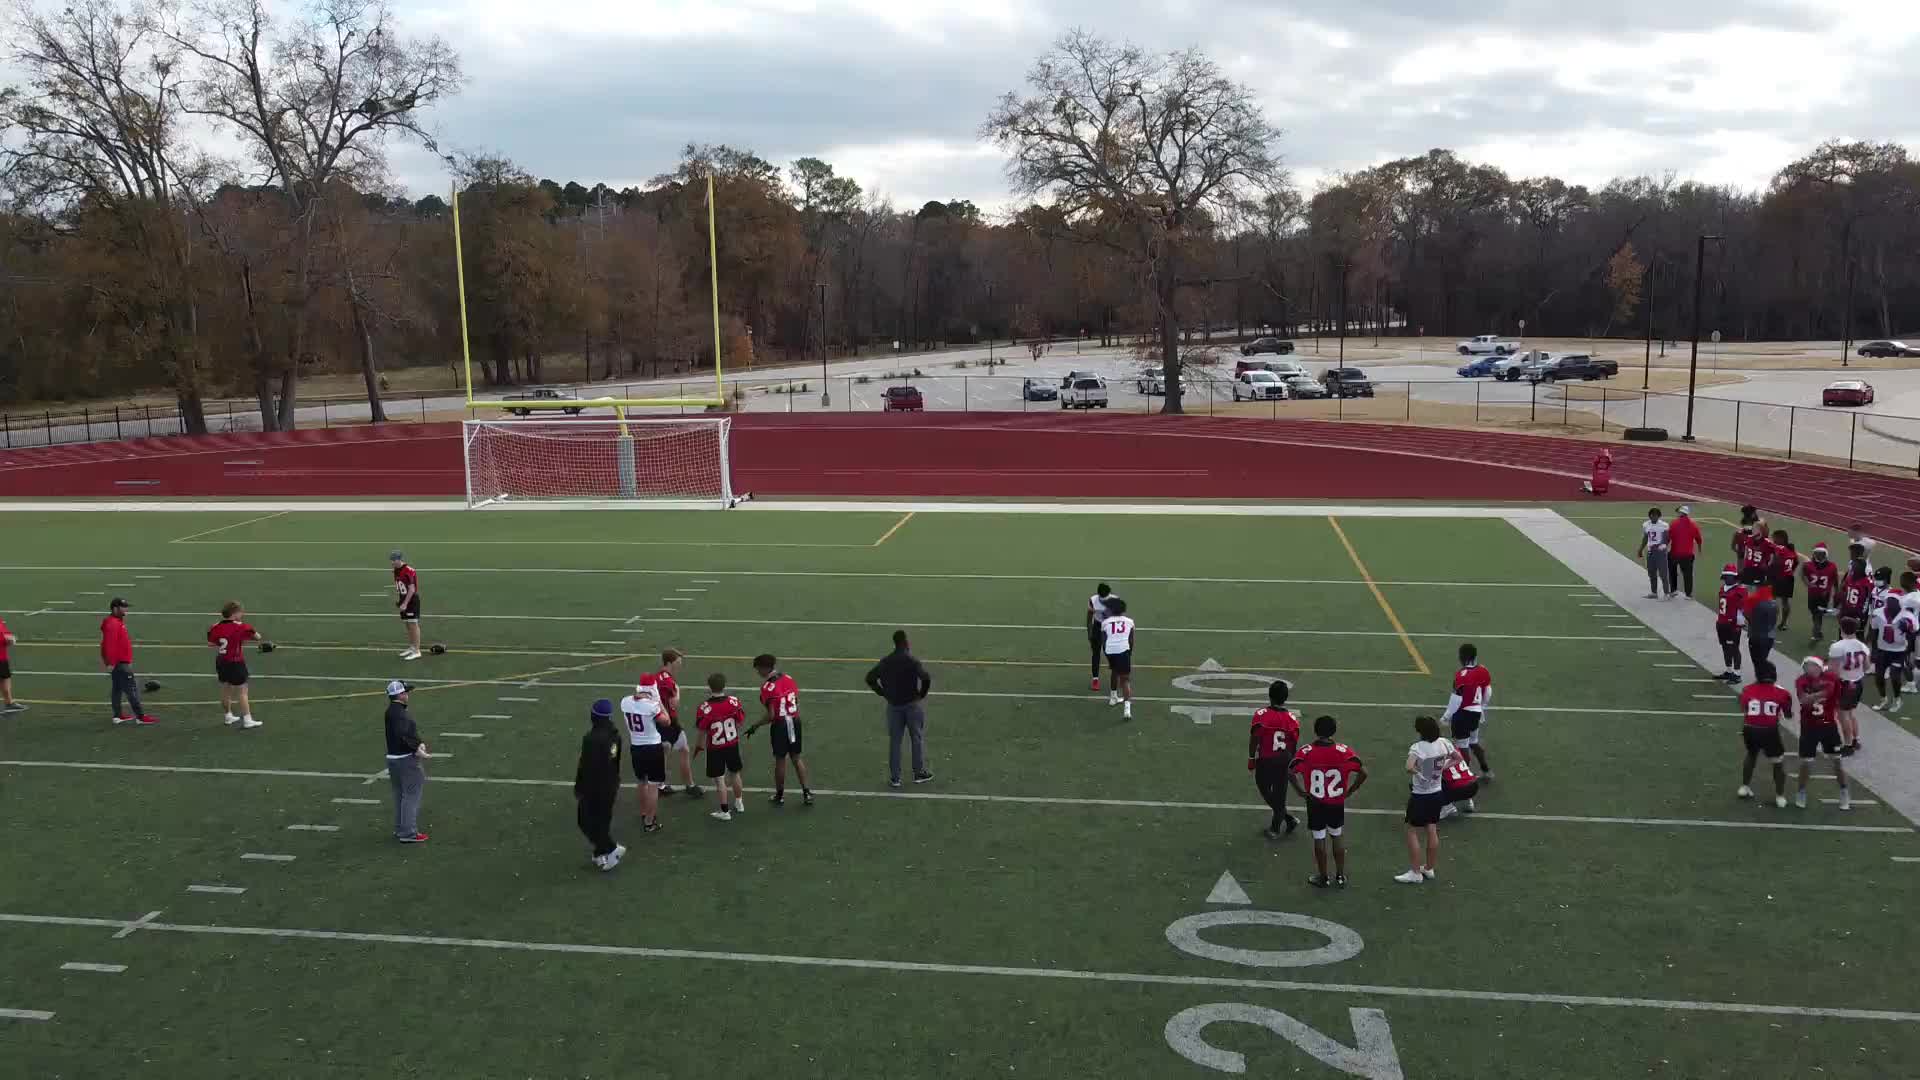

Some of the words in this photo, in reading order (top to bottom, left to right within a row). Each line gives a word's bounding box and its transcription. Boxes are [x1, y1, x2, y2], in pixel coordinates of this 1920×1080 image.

[1809, 575, 1829, 590] 23
[1109, 620, 1126, 634] 13
[779, 692, 797, 717] 13
[625, 712, 645, 733] 19
[710, 717, 738, 746] 28
[1309, 768, 1344, 799] 82
